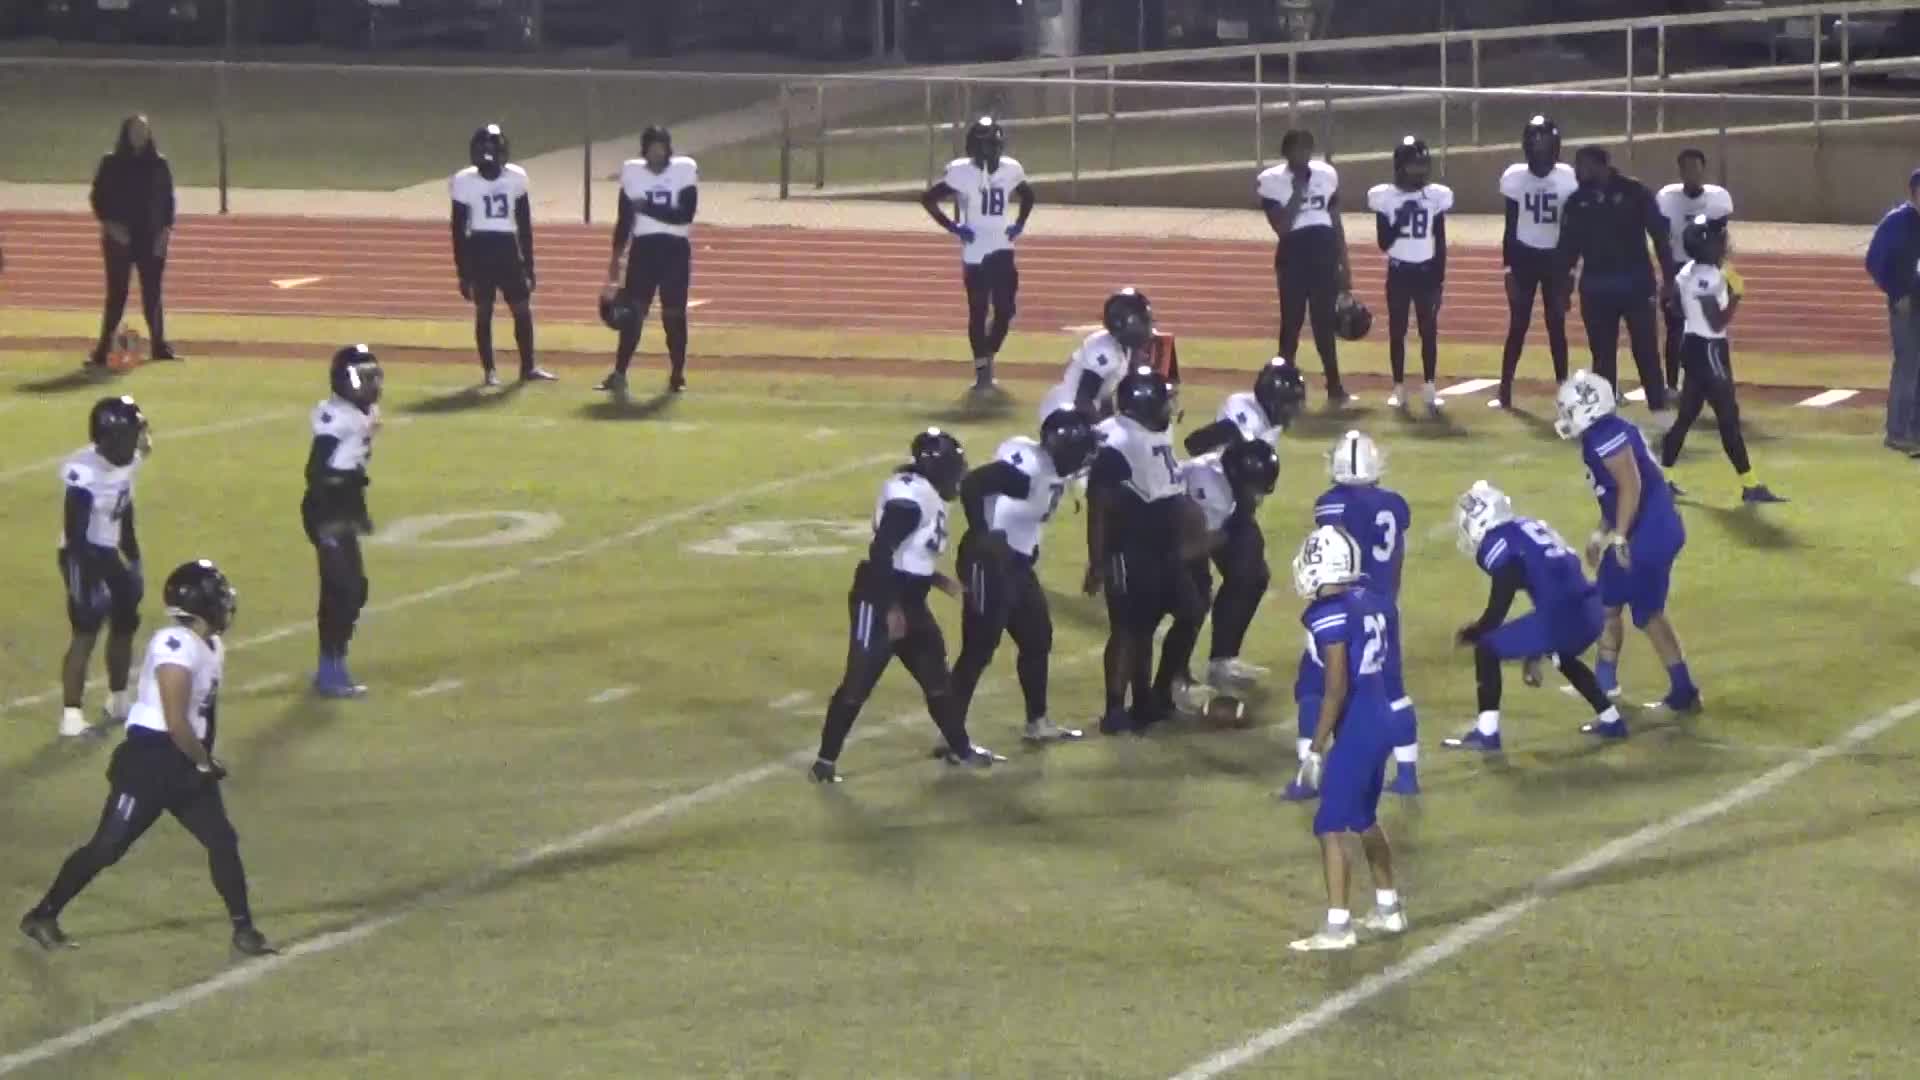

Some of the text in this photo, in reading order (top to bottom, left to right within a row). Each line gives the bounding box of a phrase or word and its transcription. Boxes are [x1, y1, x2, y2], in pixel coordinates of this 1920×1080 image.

[481, 193, 509, 218] 13
[980, 188, 1004, 216] 18
[1525, 192, 1559, 223] 45
[1371, 509, 1397, 563] 3
